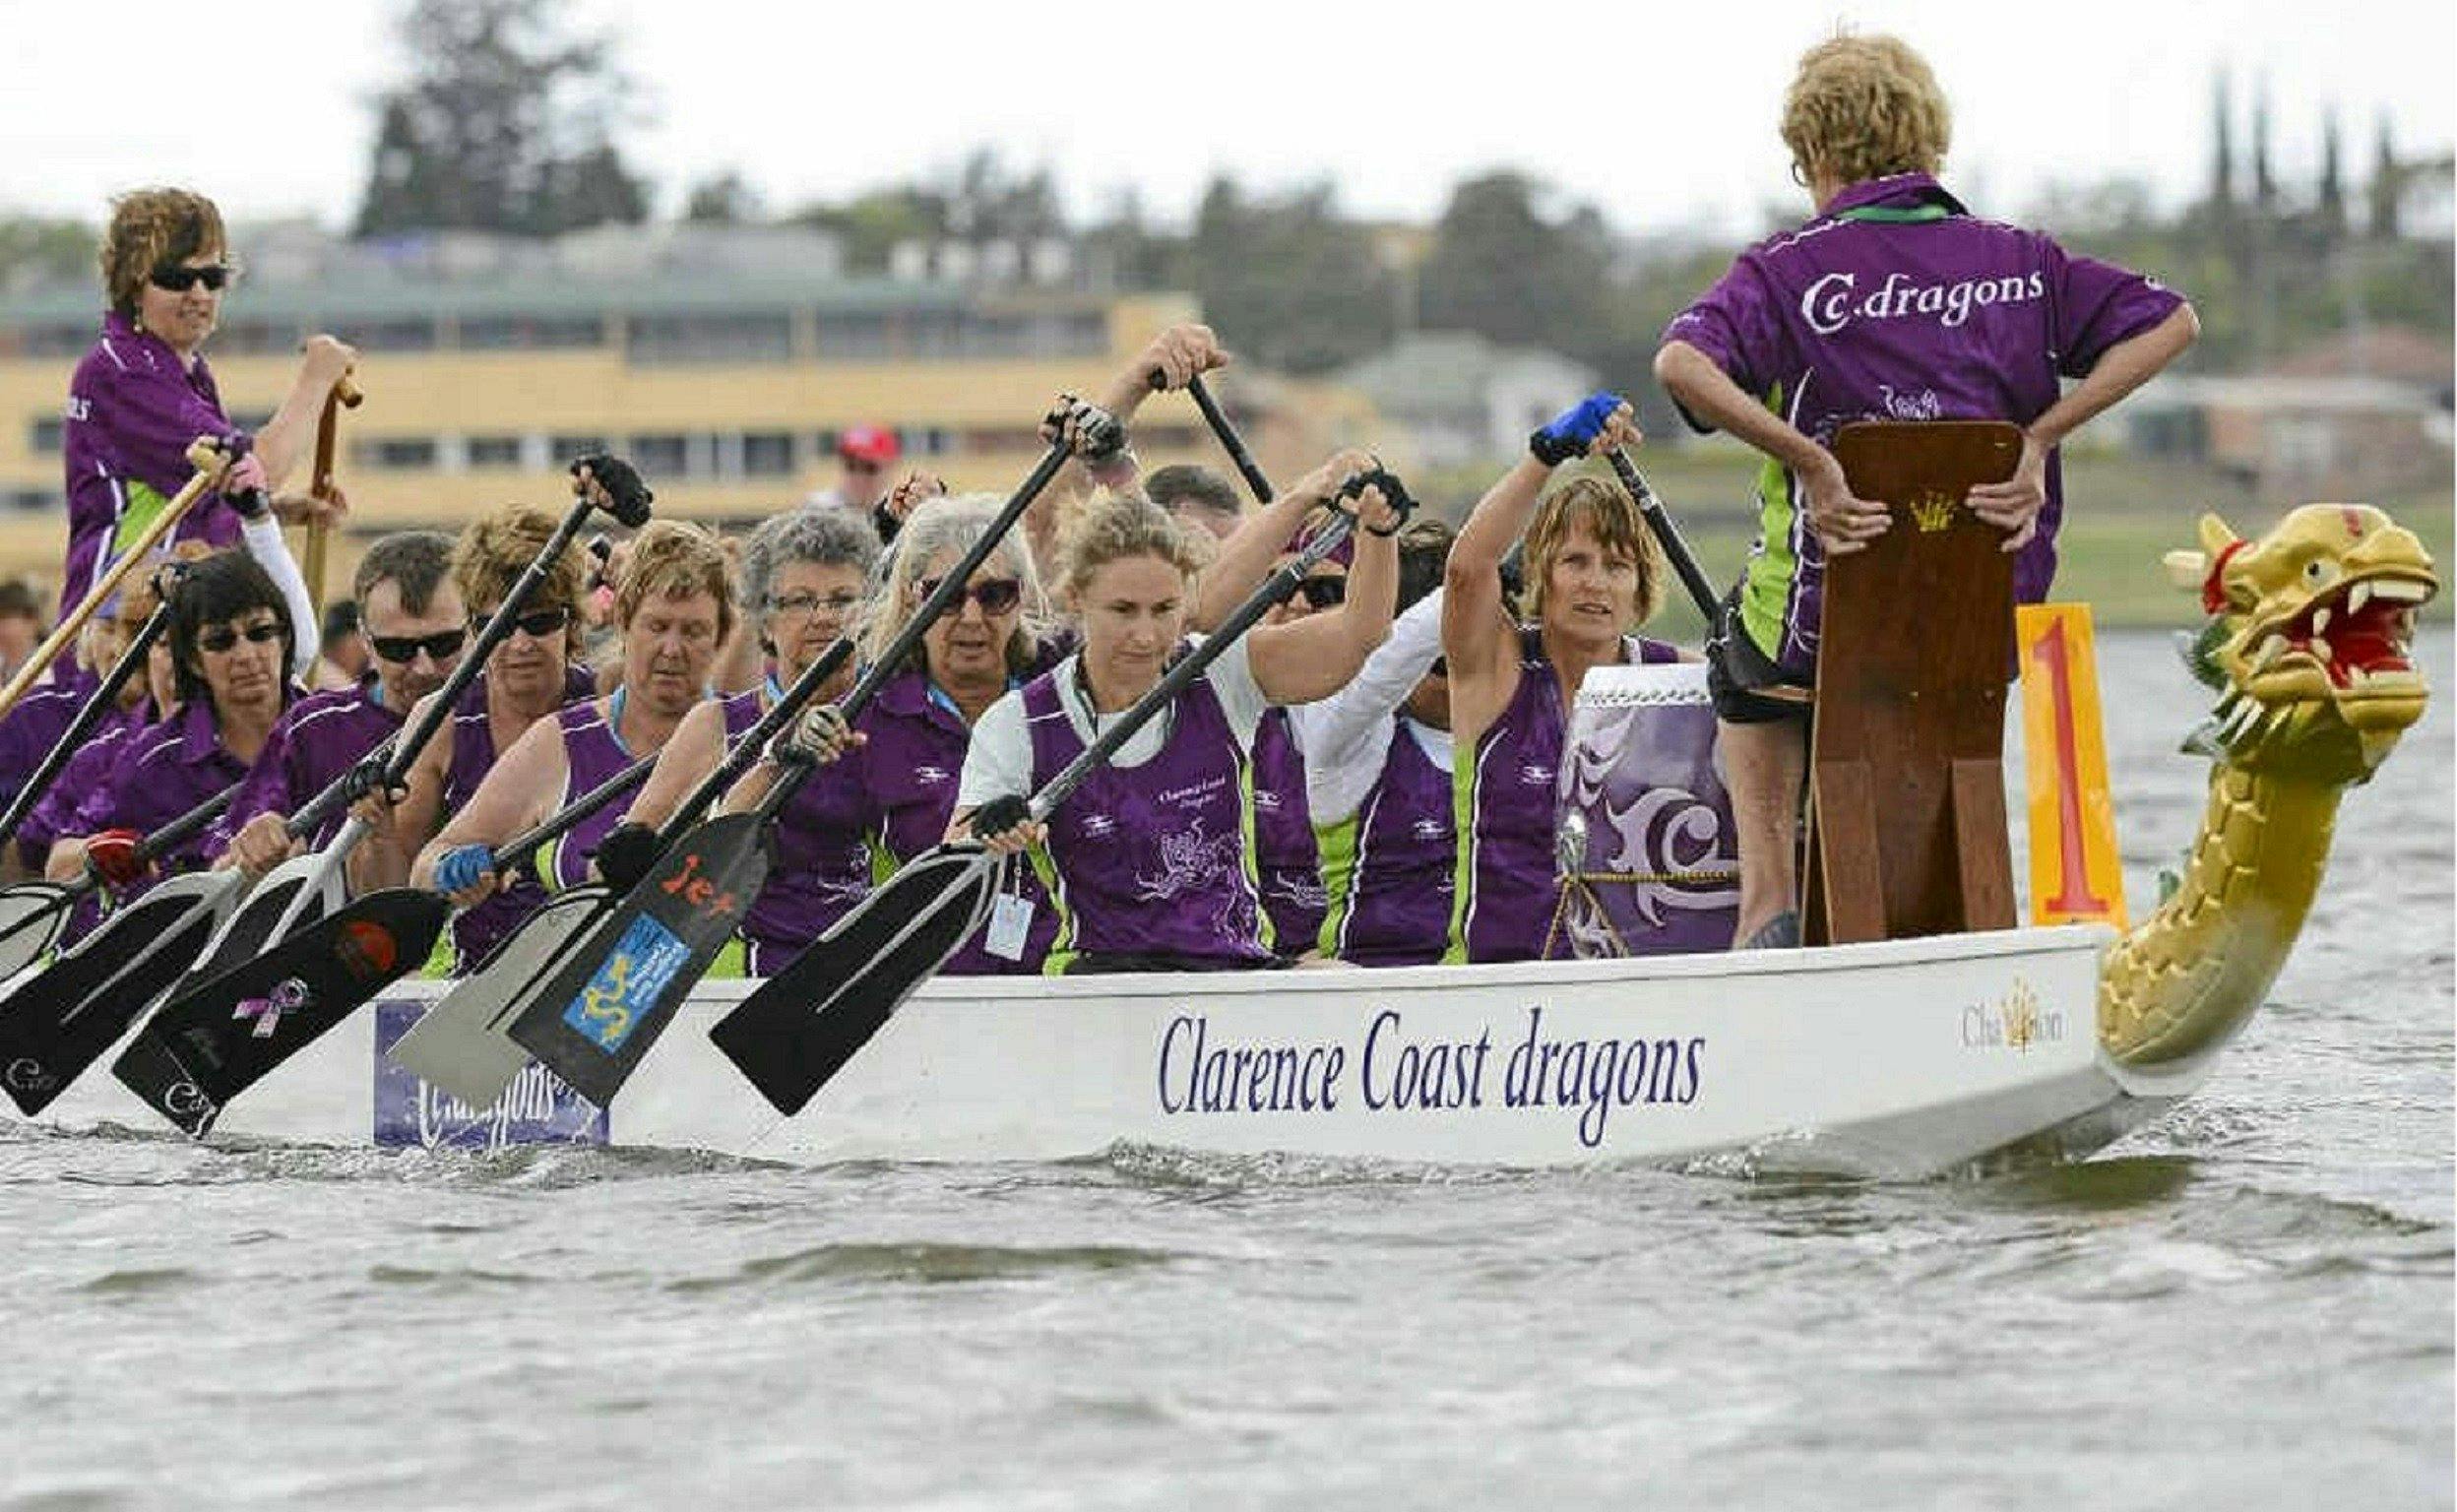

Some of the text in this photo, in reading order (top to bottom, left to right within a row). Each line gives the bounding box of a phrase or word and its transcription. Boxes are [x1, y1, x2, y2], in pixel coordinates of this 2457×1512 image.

[2033, 613, 2110, 914] 1
[1159, 1006, 1706, 1148] Clarence Coast dragons
